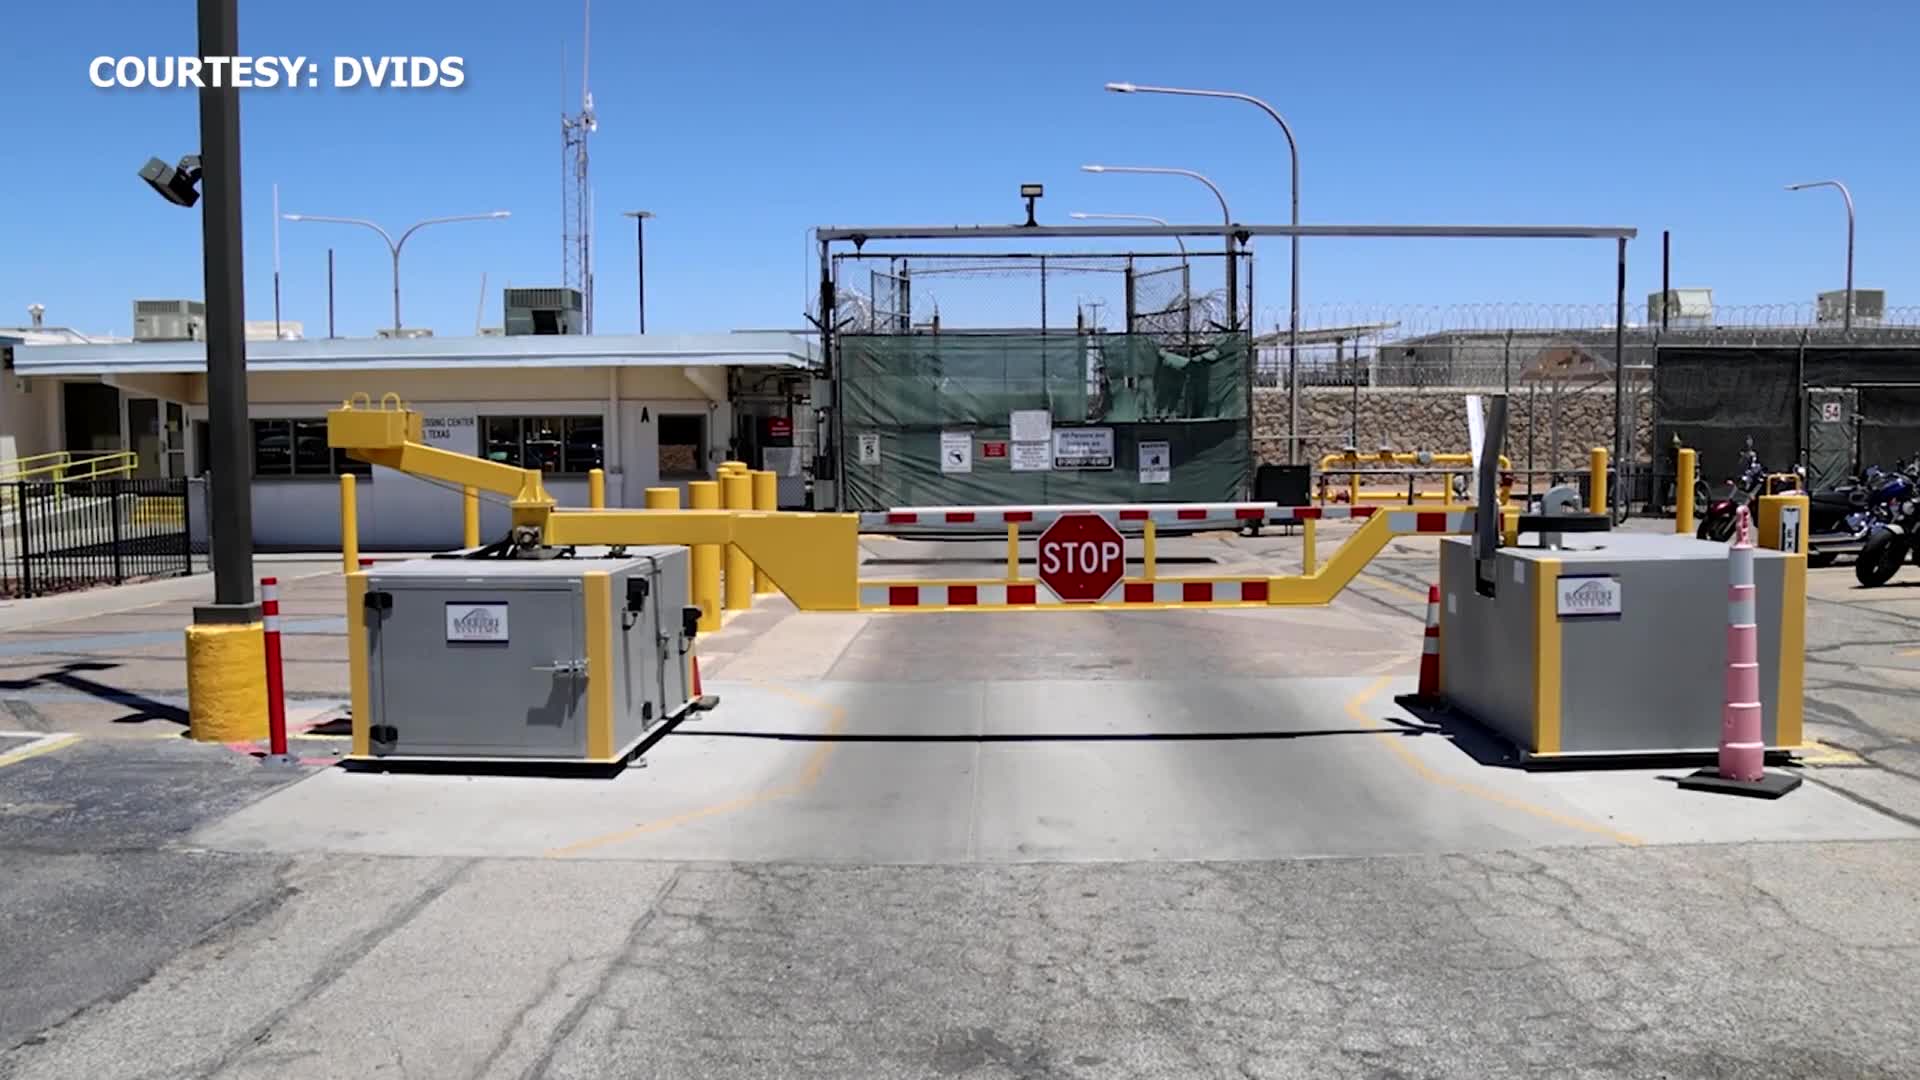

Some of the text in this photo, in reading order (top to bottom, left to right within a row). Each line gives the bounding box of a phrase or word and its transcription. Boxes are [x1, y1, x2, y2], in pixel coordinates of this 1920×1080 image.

[640, 406, 650, 423] A
[1825, 405, 1839, 420] 54
[447, 417, 475, 427] CENTER
[428, 429, 451, 439] TEXAS
[1043, 541, 1120, 574] STOP
